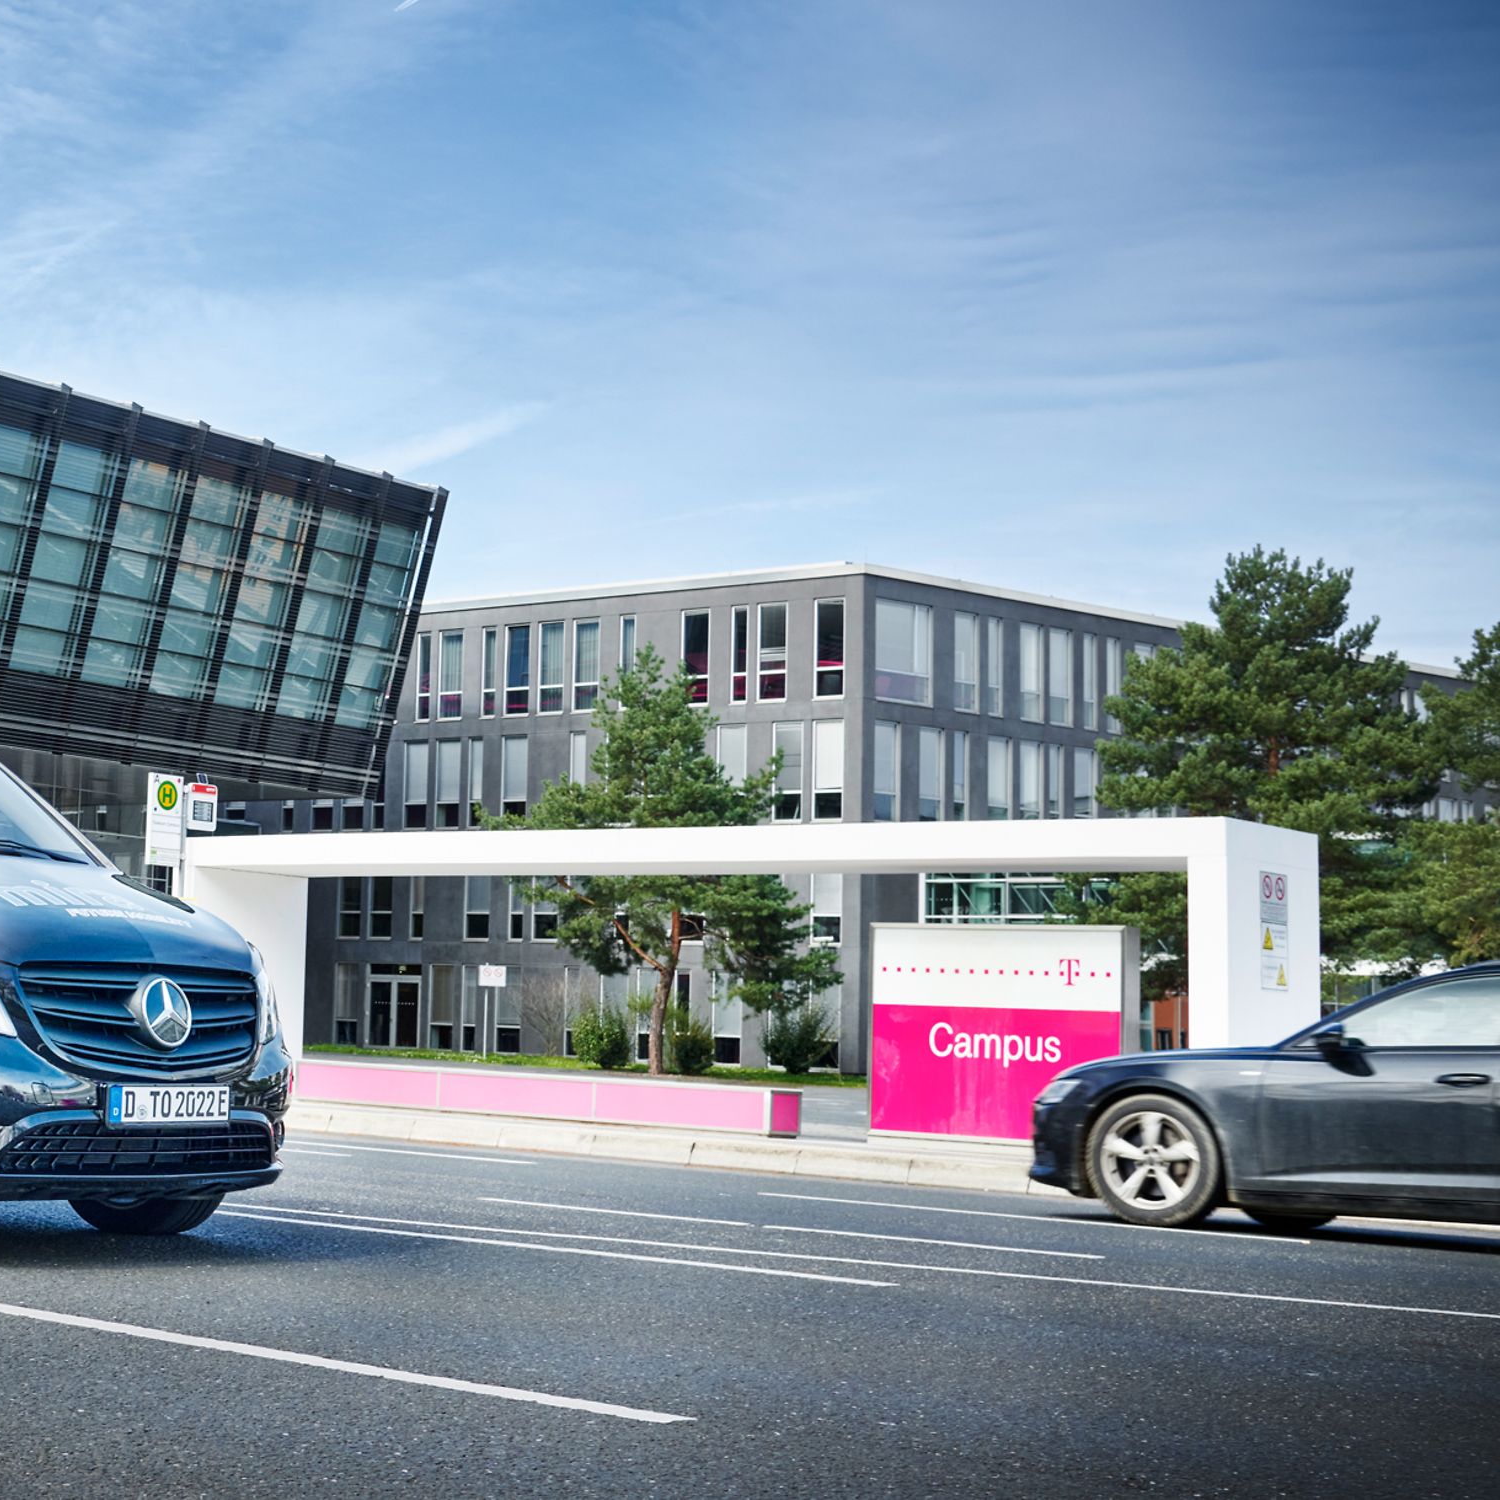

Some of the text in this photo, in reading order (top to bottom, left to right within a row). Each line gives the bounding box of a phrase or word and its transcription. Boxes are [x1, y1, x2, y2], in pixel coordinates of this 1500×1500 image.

[1059, 959, 1080, 986] T
[928, 1022, 1062, 1068] Campus
[124, 1091, 136, 1118] D
[149, 1090, 172, 1118] TO
